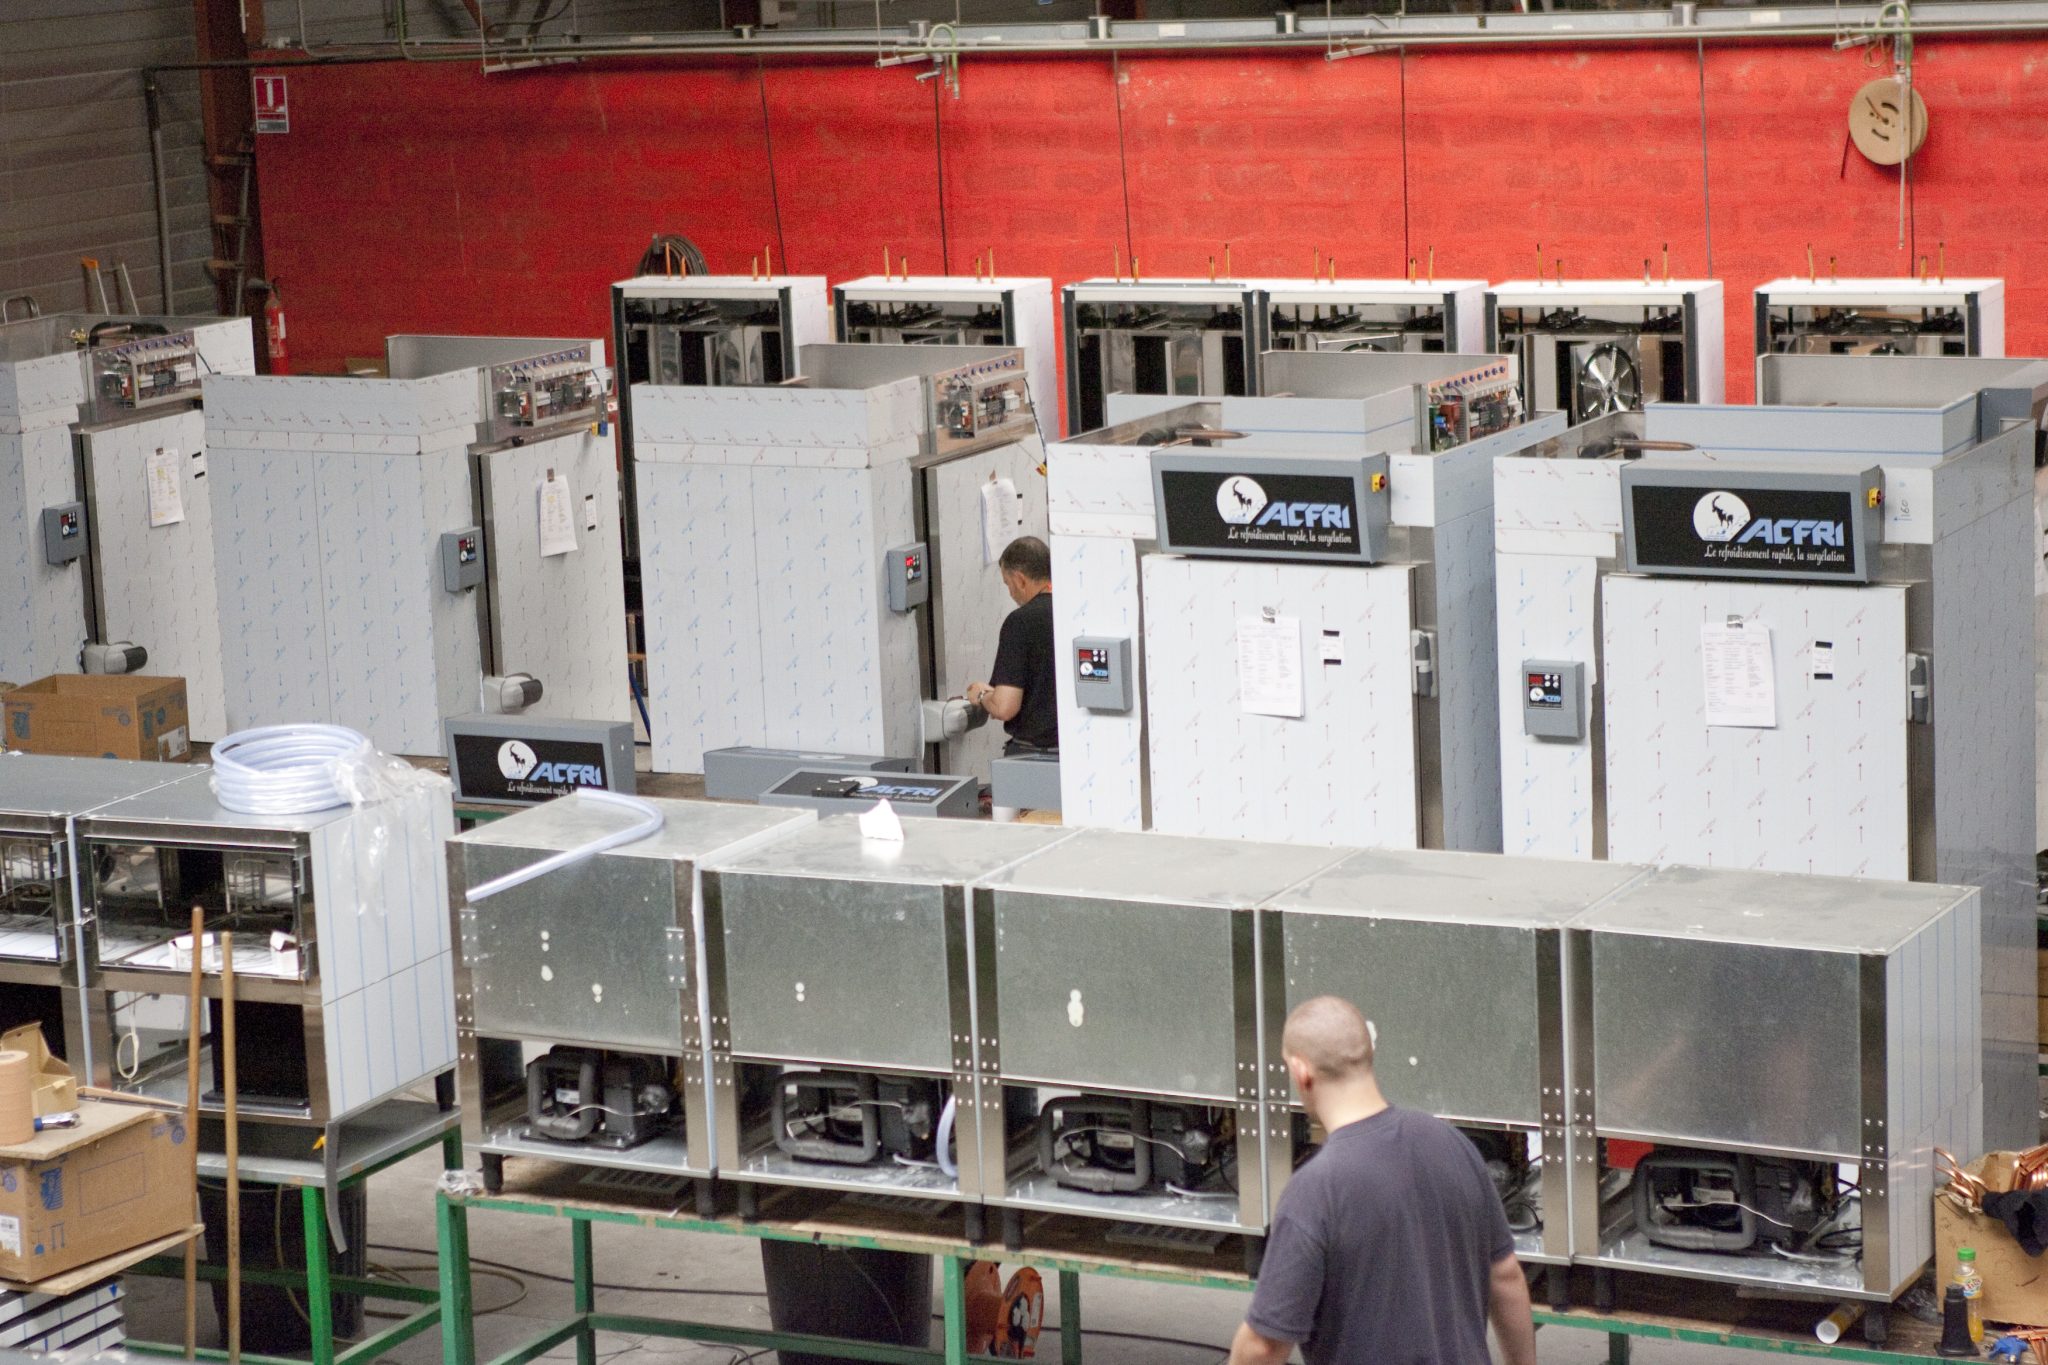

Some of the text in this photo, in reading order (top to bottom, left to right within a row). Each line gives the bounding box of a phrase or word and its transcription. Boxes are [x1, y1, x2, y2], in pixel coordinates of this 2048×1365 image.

[1256, 502, 1350, 528] ACFRI
[1227, 526, 1239, 540] Le
[1309, 529, 1316, 542] la
[1737, 518, 1845, 547] ACFRI
[1704, 544, 1717, 558] Le
[1718, 544, 1770, 562] refroidissement
[1771, 546, 1796, 564] rapide,
[1797, 547, 1805, 560] la
[529, 762, 602, 785] ACFRI
[857, 785, 943, 796] ACFRI
